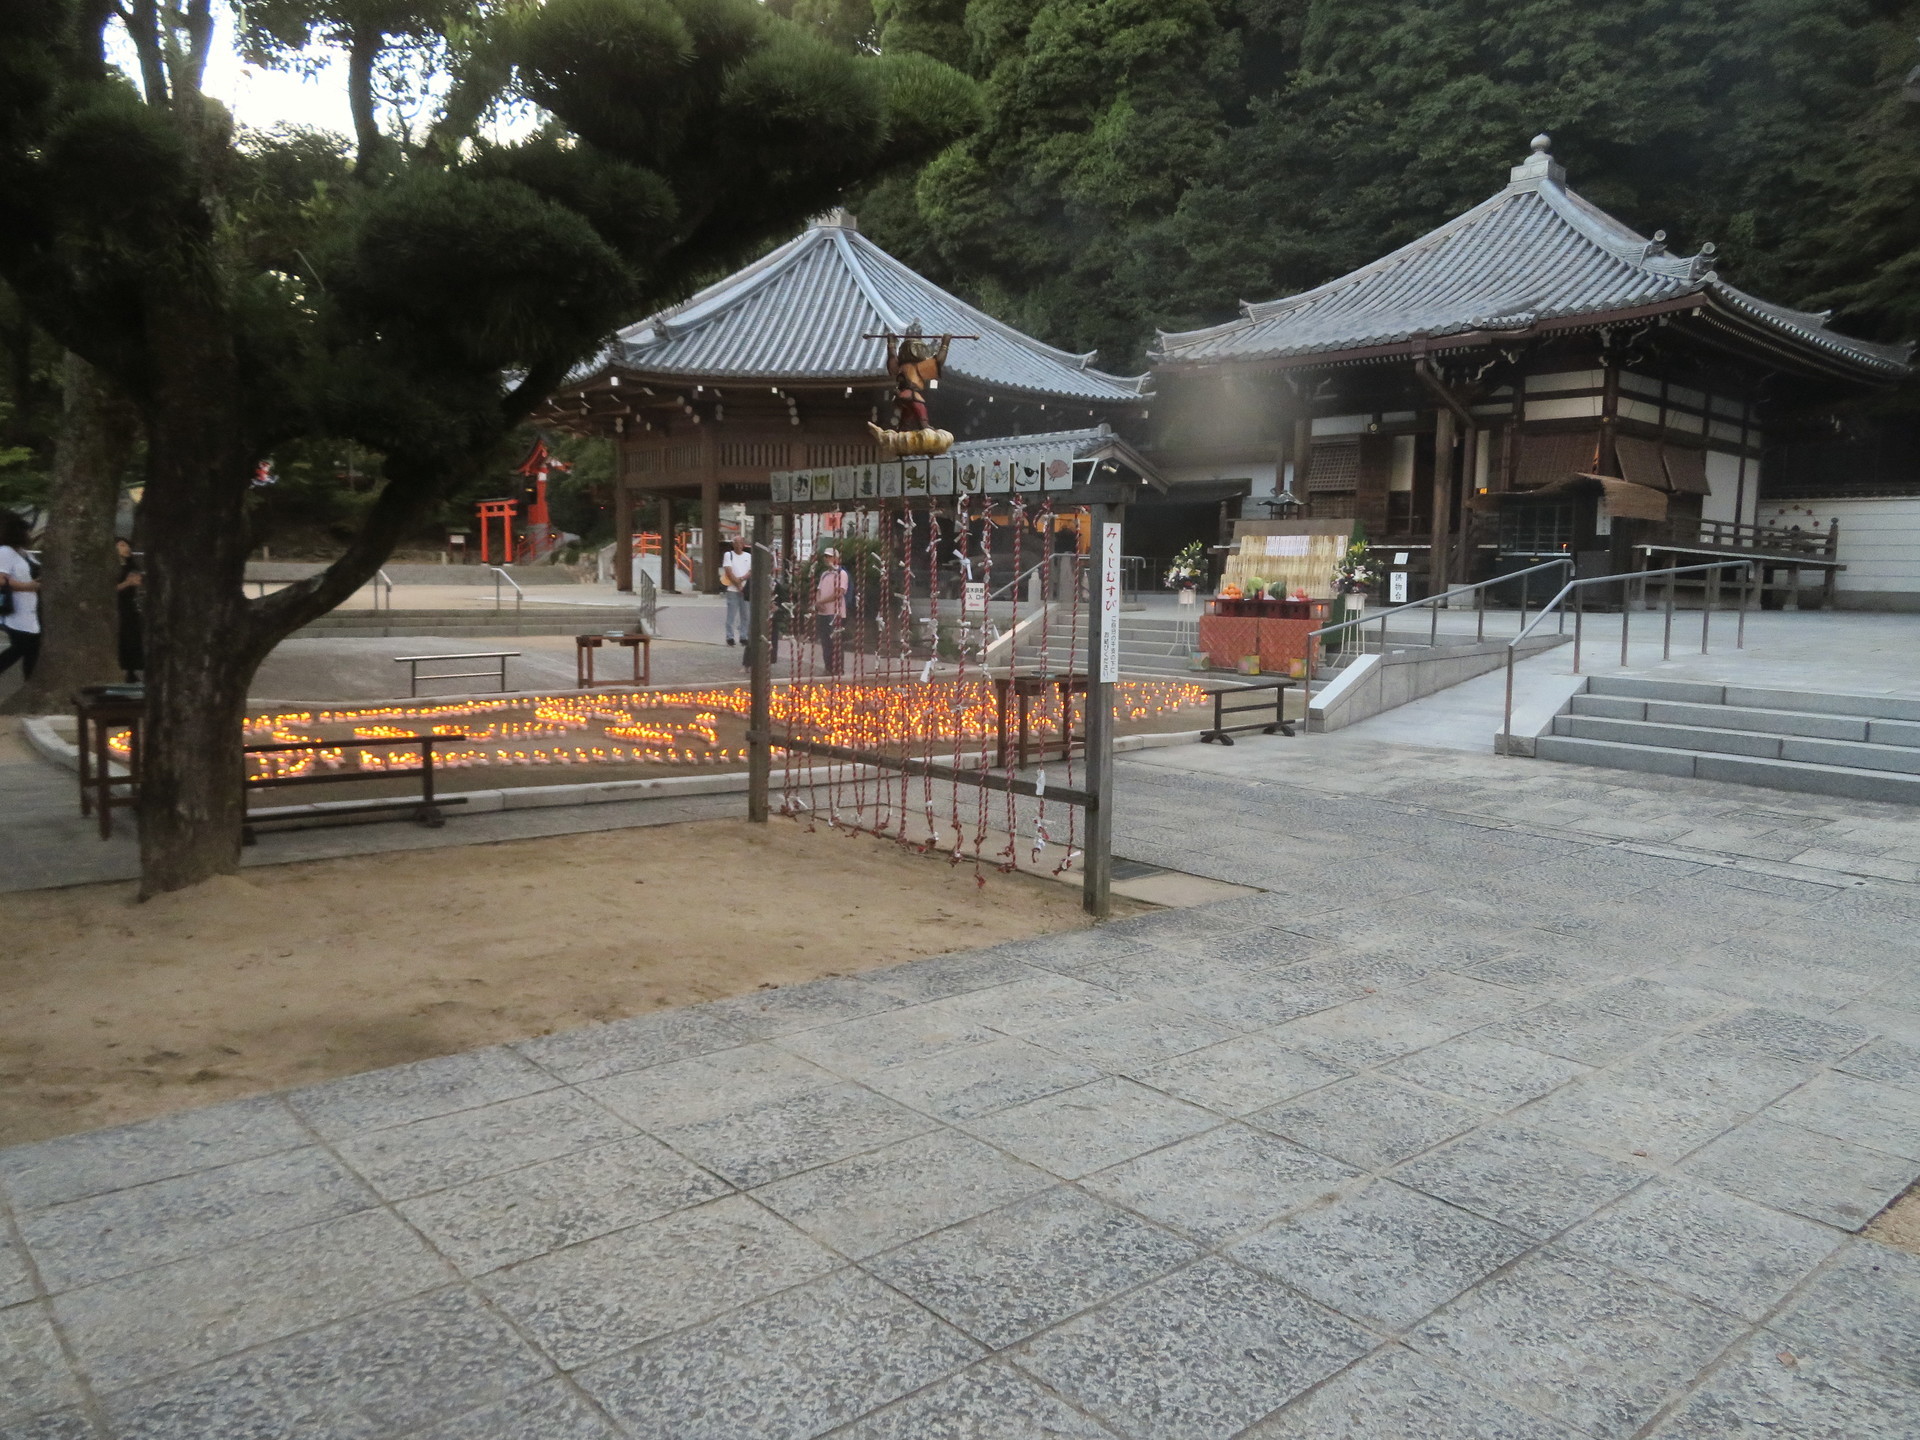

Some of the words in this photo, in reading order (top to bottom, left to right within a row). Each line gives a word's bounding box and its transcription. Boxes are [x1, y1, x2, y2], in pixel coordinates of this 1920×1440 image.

[1105, 527, 1117, 611] みくじむすび
